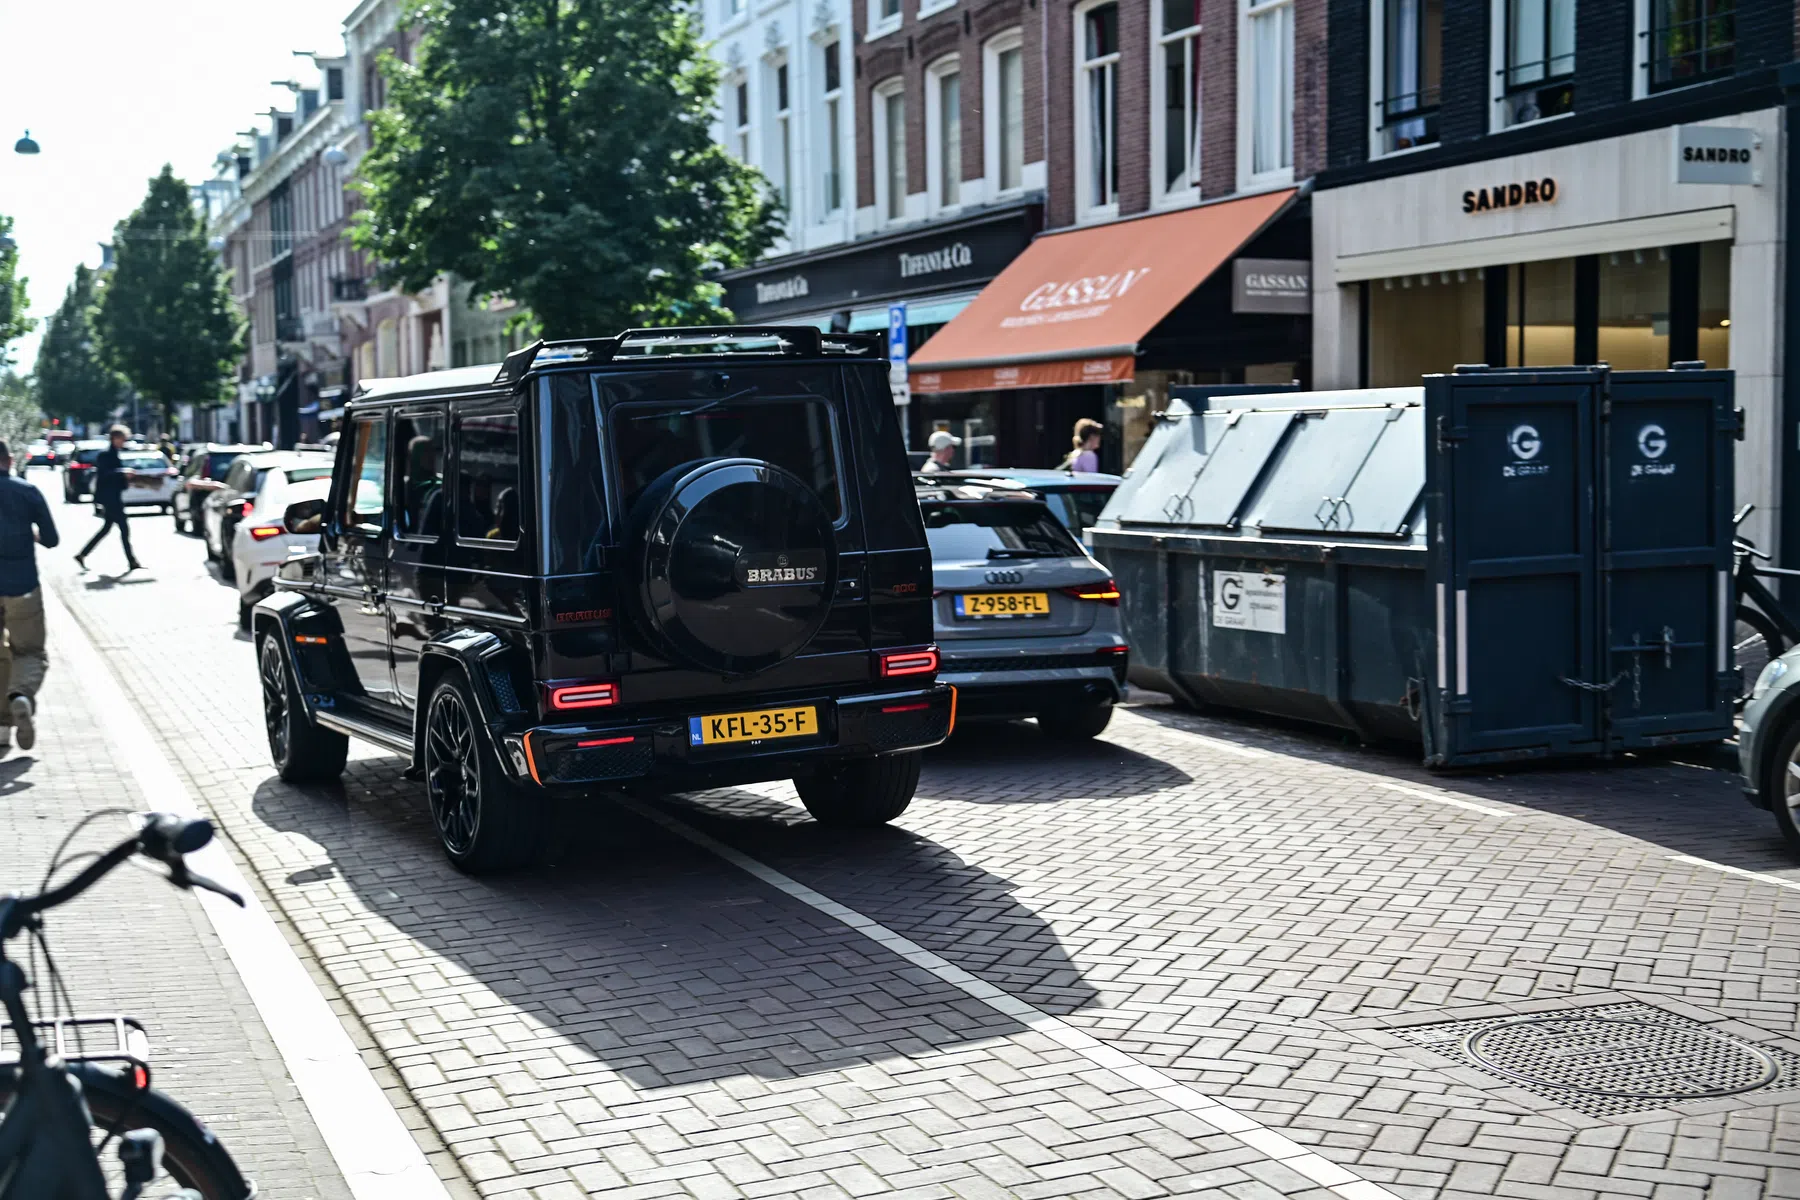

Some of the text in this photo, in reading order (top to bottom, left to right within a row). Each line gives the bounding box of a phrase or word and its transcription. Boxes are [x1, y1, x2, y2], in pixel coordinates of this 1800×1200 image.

[1683, 147, 1751, 163] SANDRO
[1462, 178, 1556, 213] SANDRO
[1245, 273, 1309, 289] GASSAN
[1638, 424, 1667, 458] G
[970, 596, 1042, 612] Z-958-FL
[711, 711, 806, 739] KFL-35-F
